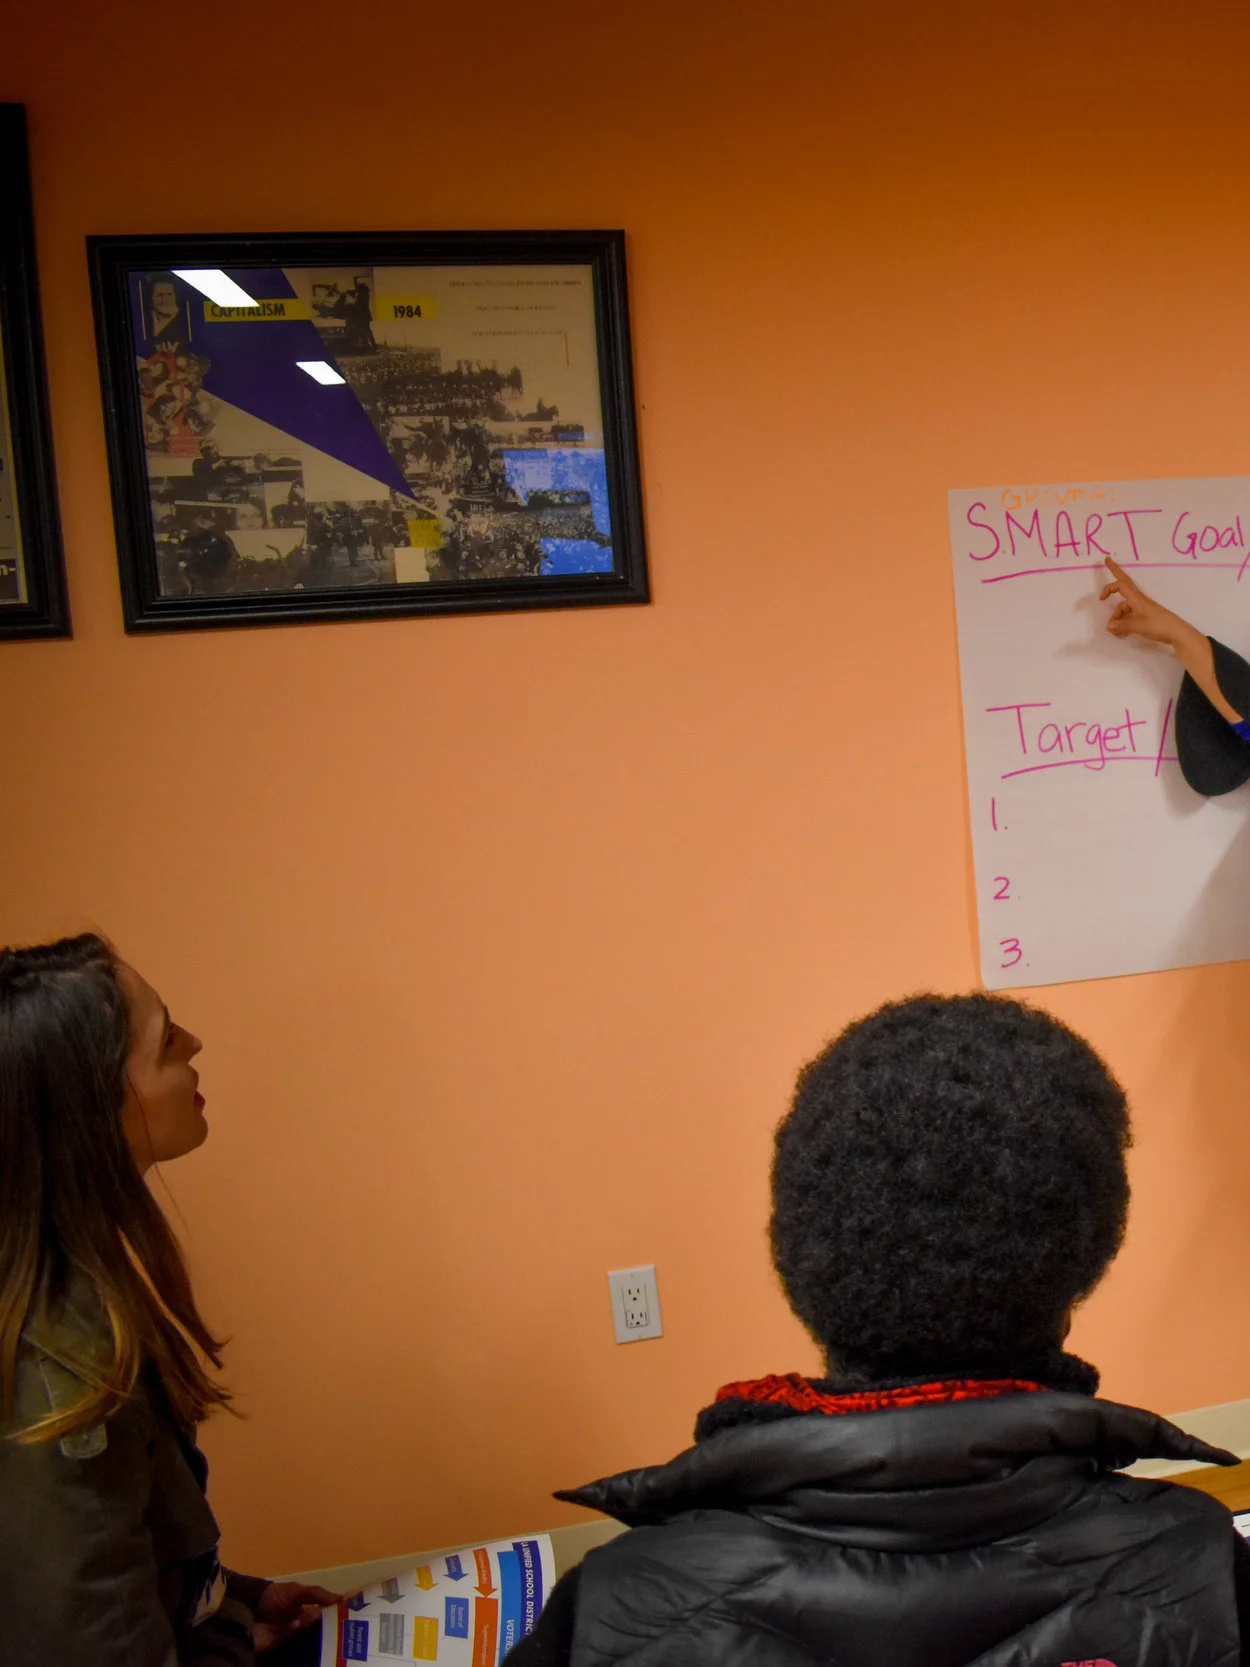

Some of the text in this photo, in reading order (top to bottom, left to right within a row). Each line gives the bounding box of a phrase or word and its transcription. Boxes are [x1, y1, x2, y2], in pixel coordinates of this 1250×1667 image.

[211, 303, 286, 317] CAPITALISM
[392, 305, 422, 318] 1984
[526, 1569, 535, 1599] SCHOOL
